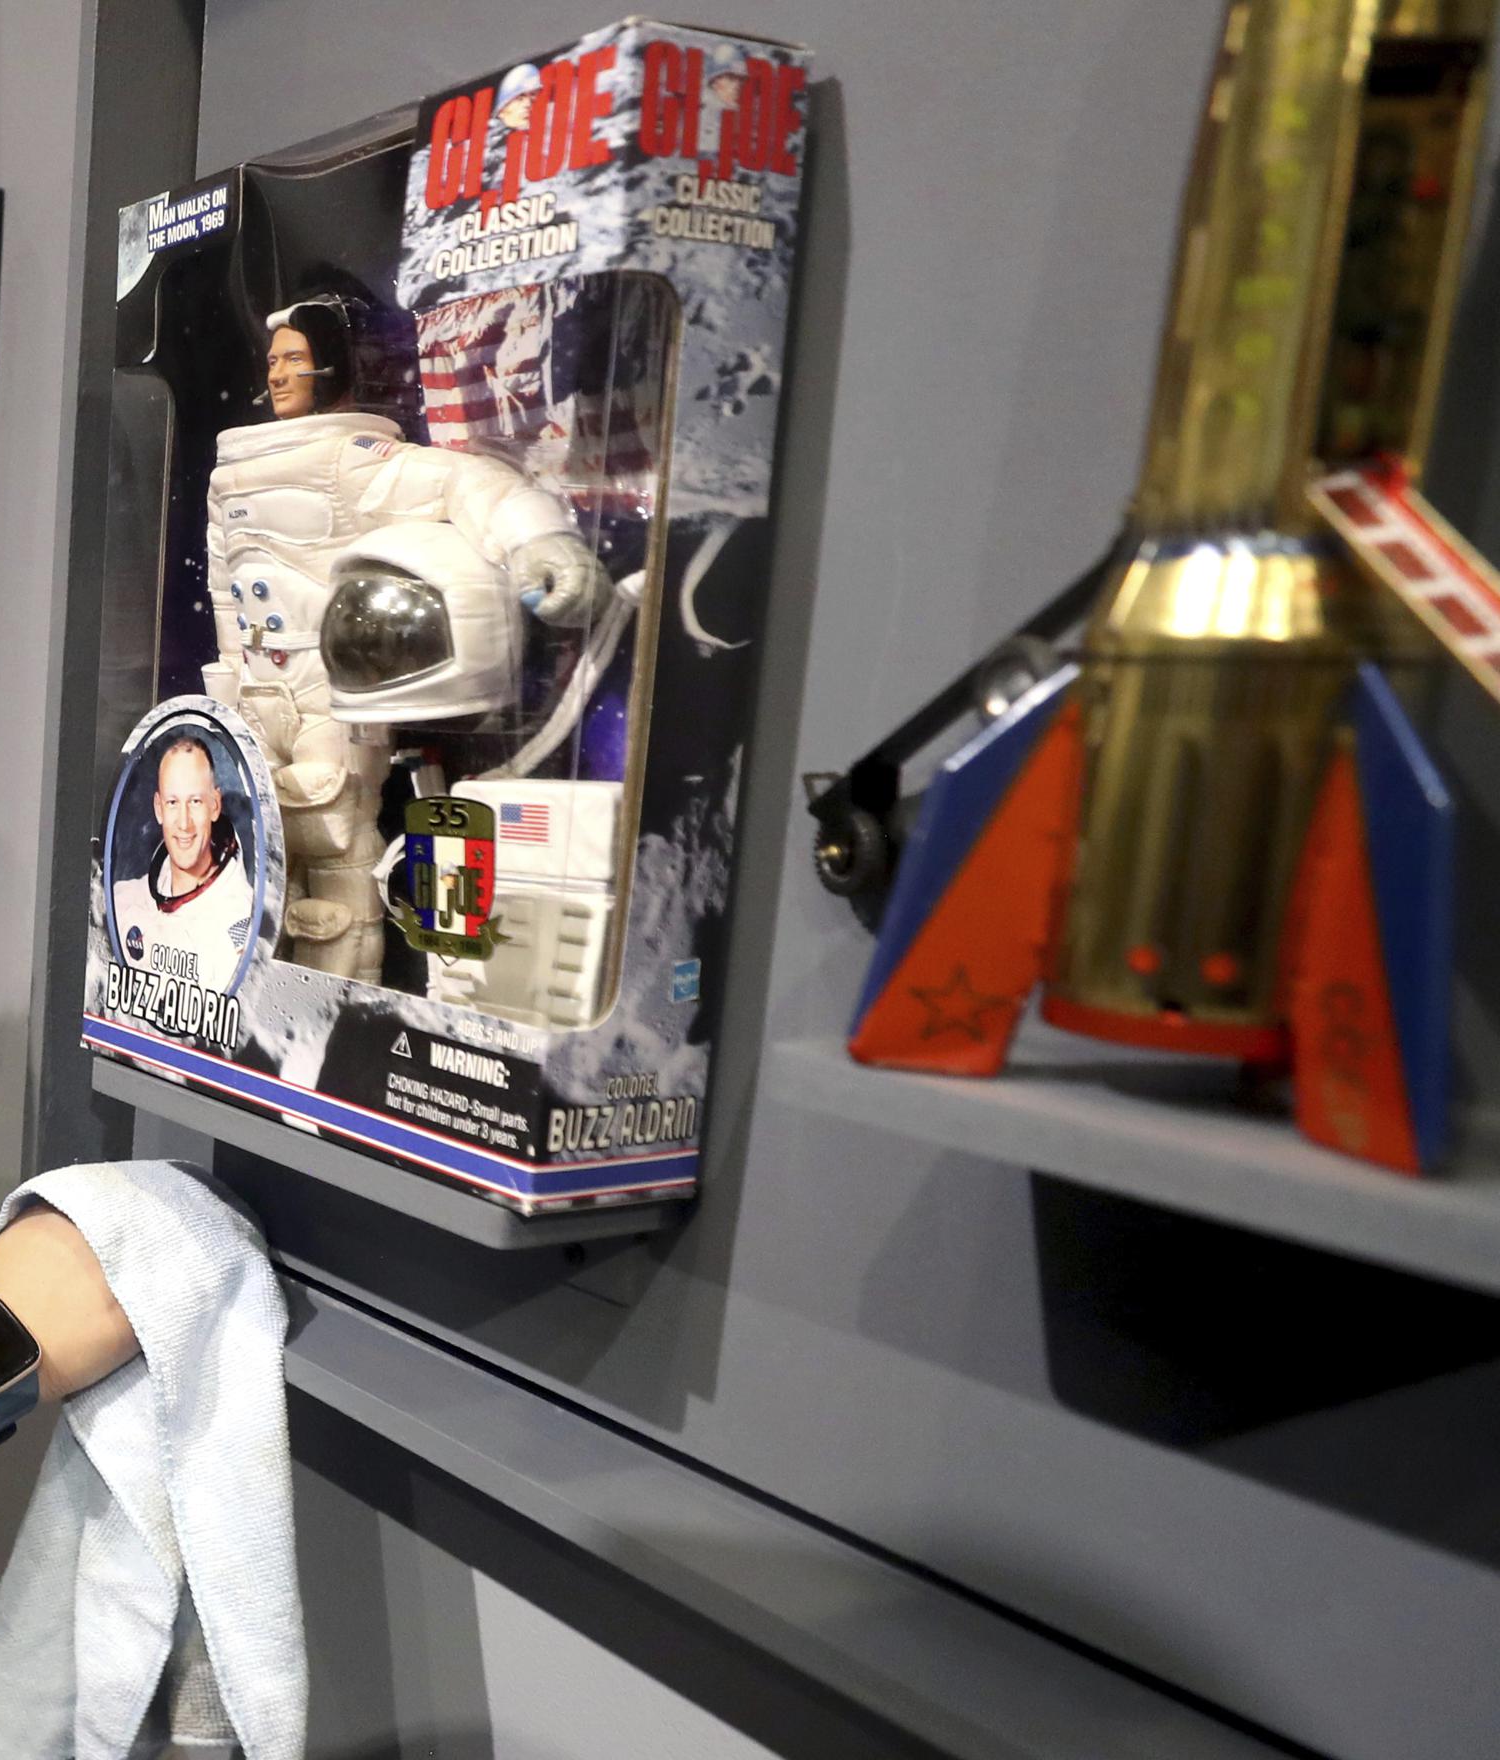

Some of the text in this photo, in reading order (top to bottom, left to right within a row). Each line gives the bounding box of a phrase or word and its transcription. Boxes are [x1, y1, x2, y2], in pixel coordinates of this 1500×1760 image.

[480, 43, 618, 230] JOE
[639, 39, 805, 199] GI JOE
[148, 187, 227, 231] MAN WALKS ON
[675, 174, 761, 213] CLASSIC
[148, 209, 225, 250] THE MOON, 1969
[458, 191, 556, 243] CLASSIC
[654, 206, 776, 249] COLLECTION
[435, 221, 579, 280] COLLECTION
[428, 801, 470, 828] 35
[151, 943, 200, 982] COLONEL
[106, 962, 241, 1050] BUZZ ALDRIN
[495, 1029, 519, 1051] AND
[521, 1036, 539, 1055] UP
[387, 1072, 429, 1100] CHOKING
[430, 1041, 511, 1090] WARNING:
[605, 1071, 660, 1100] COLONEL
[385, 1090, 402, 1110] Not
[402, 1095, 416, 1114] for
[415, 1102, 452, 1127] children
[452, 1115, 480, 1137] under
[480, 1121, 489, 1140] 3
[547, 1096, 697, 1152] BUZZ ALDRIN
